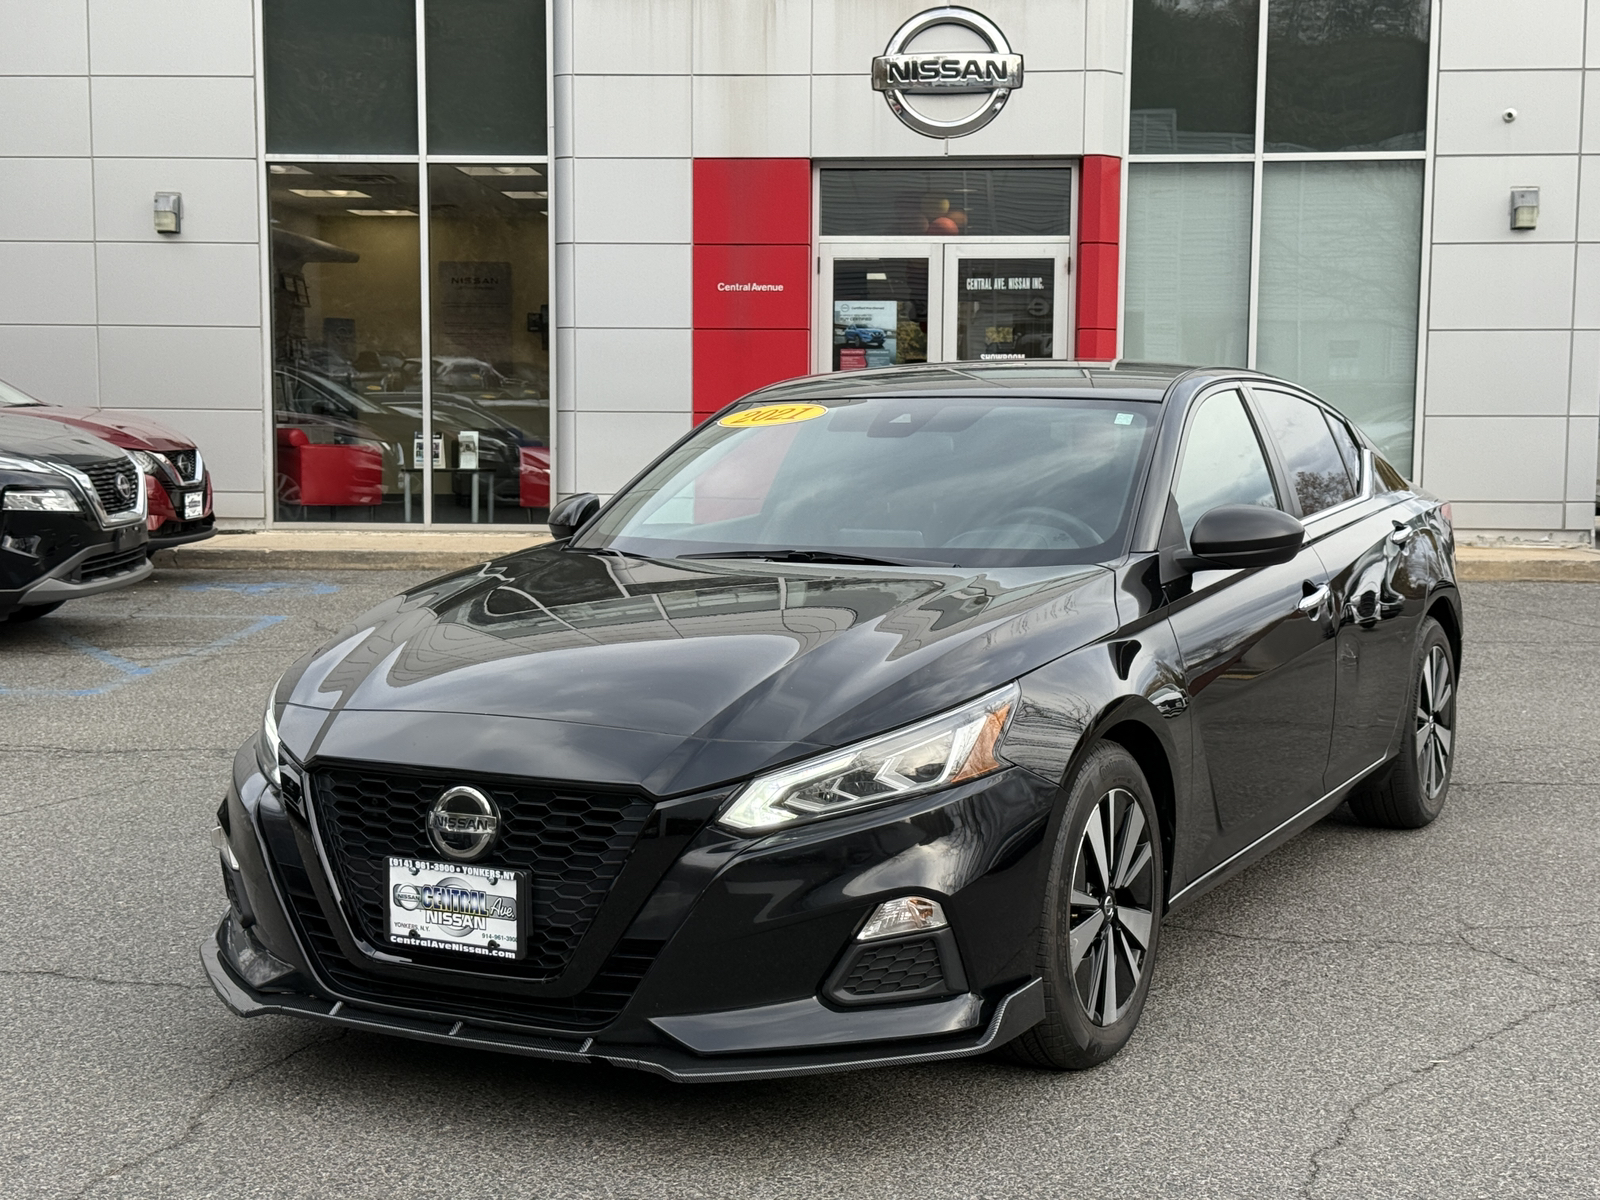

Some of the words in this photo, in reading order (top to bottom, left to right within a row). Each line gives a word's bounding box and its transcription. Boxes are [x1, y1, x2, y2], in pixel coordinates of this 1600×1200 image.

[887, 60, 1008, 82] NISSAN
[717, 282, 751, 291] Central
[751, 282, 784, 291] Avenue
[966, 278, 992, 290] CENTRAL
[994, 278, 1007, 290] AVE.
[1008, 277, 1031, 289] NISSAN
[1032, 277, 1044, 289] INC.
[730, 407, 815, 424] 2021
[434, 815, 488, 830] NISSAN
[389, 857, 413, 868] (914)
[415, 860, 455, 873] 961-3900
[422, 884, 489, 916] CENTRAL
[490, 897, 515, 918] Ave.
[425, 909, 487, 930] NISSAN
[390, 935, 516, 959] CentralAveNissan.com
